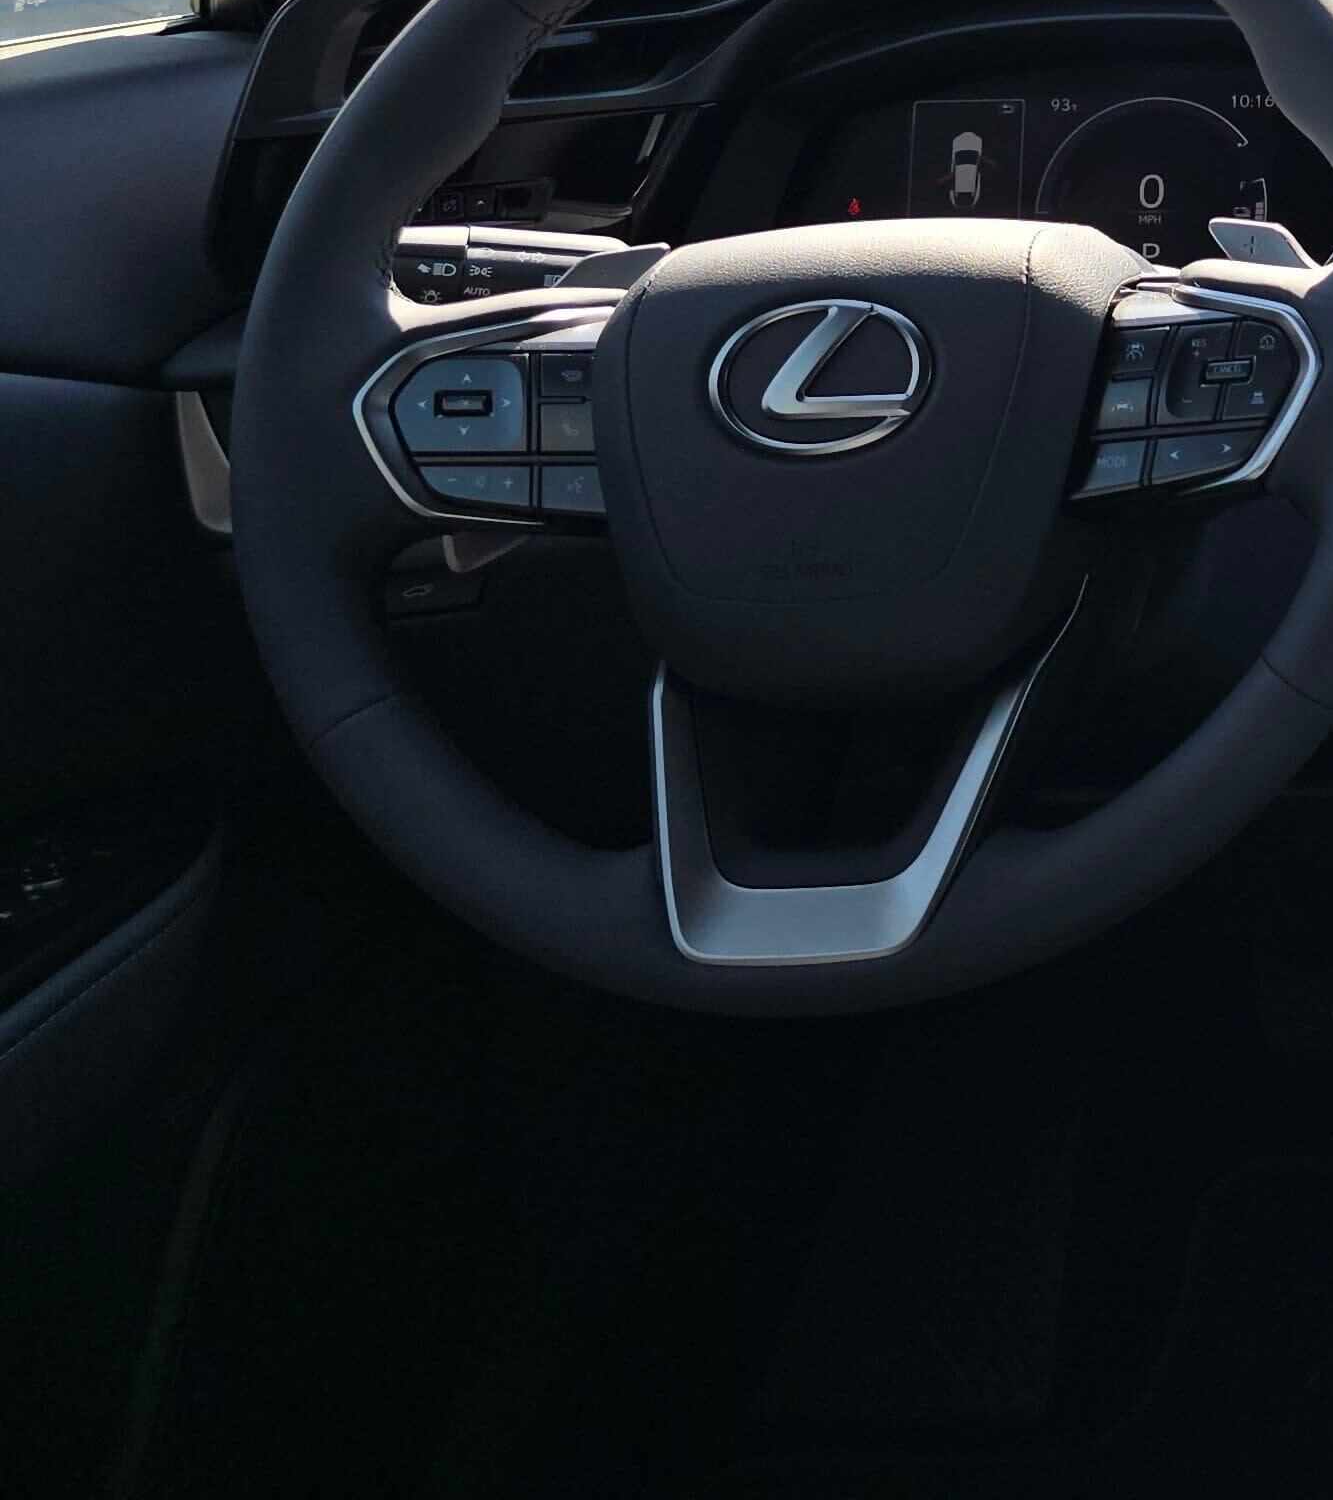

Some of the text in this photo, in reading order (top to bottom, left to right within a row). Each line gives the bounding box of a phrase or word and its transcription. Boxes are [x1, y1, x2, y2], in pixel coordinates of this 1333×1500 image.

[1231, 94, 1275, 109] 10:16
[1139, 174, 1165, 209] 0
[1138, 214, 1162, 225] MPH
[463, 286, 491, 296] AUTO
[1096, 456, 1129, 468] MODE
